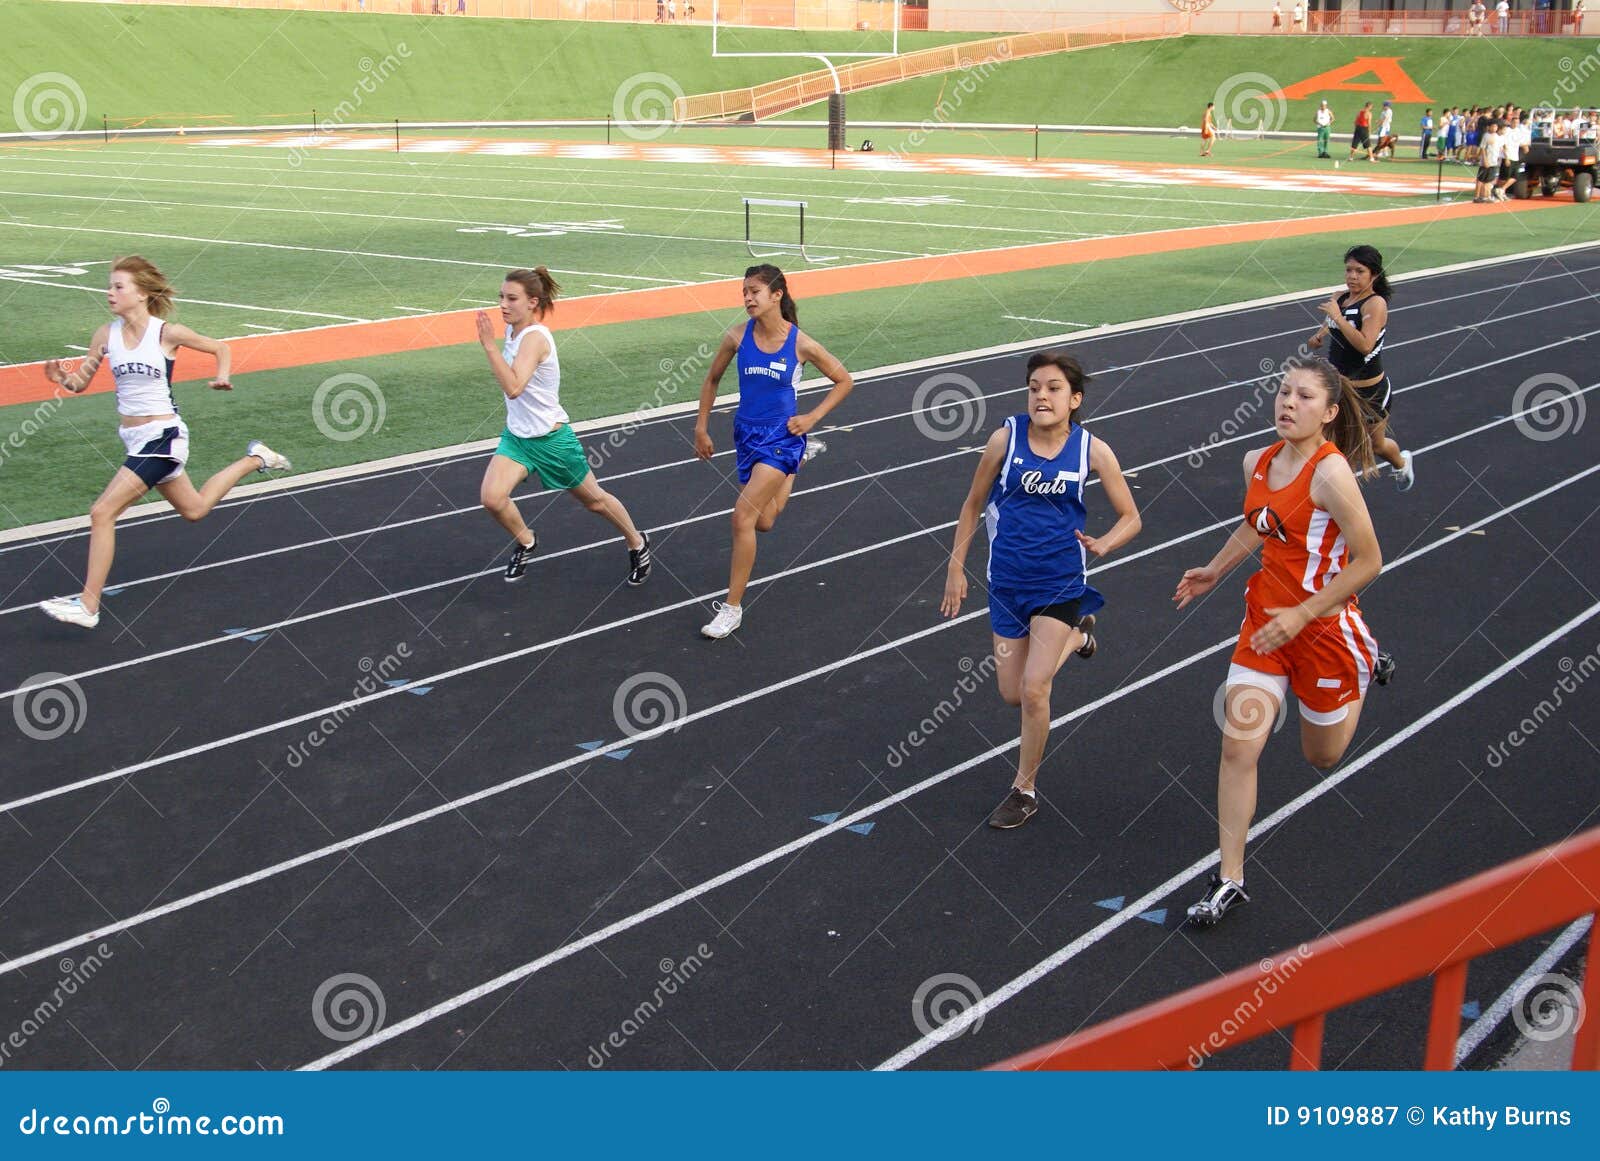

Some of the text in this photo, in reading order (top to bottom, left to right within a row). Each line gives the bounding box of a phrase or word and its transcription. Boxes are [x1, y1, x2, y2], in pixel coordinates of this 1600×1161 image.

[1255, 56, 1436, 103] A
[744, 366, 781, 380] LOVINGTON
[1021, 470, 1067, 494] Cats
